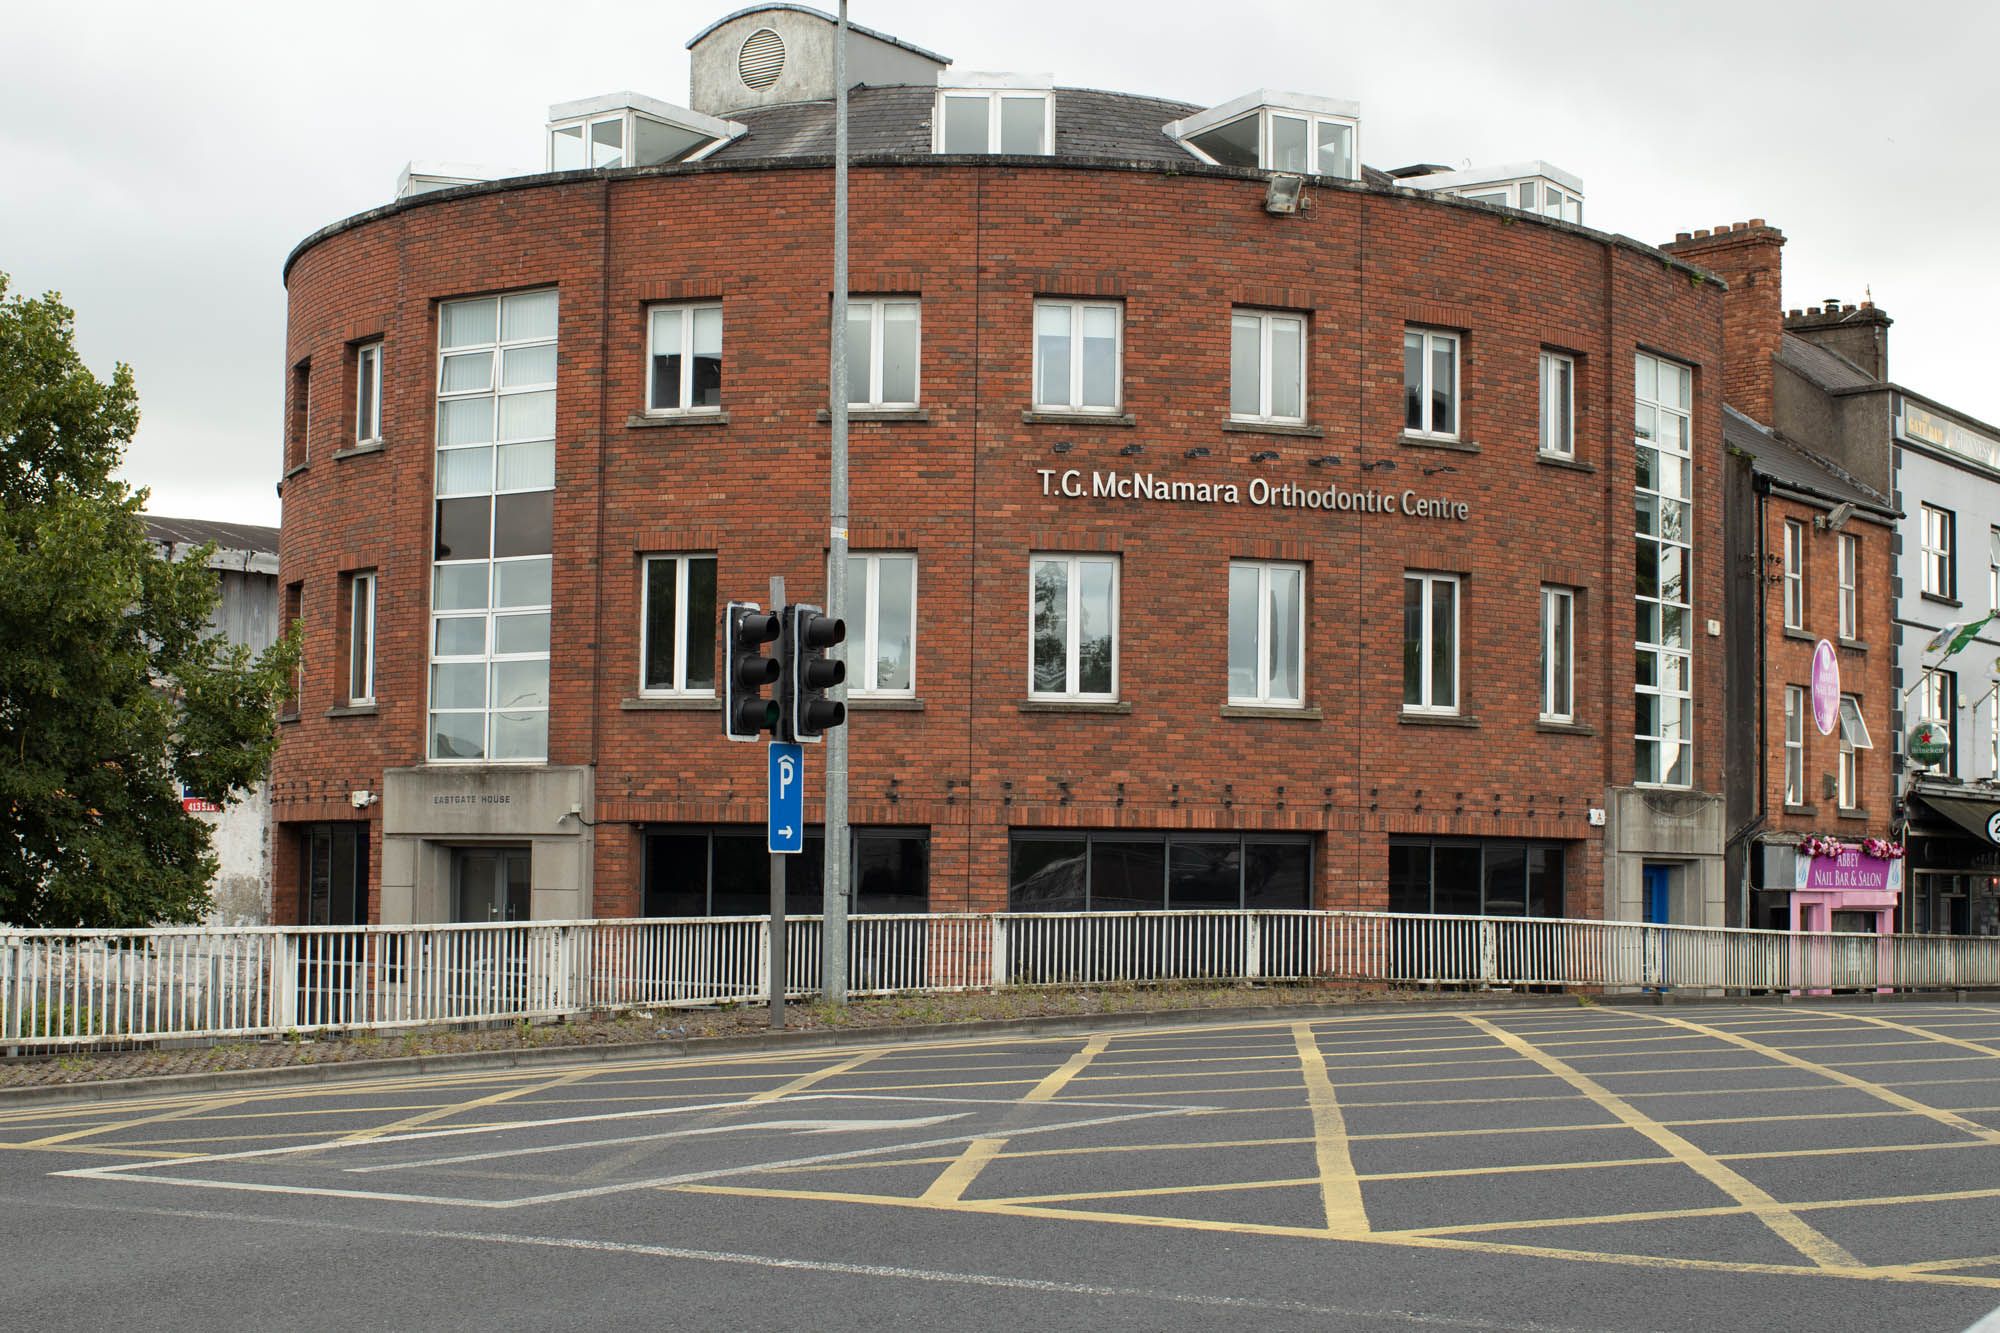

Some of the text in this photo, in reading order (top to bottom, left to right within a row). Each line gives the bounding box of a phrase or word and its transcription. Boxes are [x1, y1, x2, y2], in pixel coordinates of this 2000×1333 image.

[1037, 469, 1469, 520] T.G. McNamara Orthodontic Centre
[780, 762, 793, 799] P
[434, 795, 511, 804] EASTGATE HOUSE
[1836, 853, 1859, 867] ABBEY
[1850, 870, 1857, 886] &
